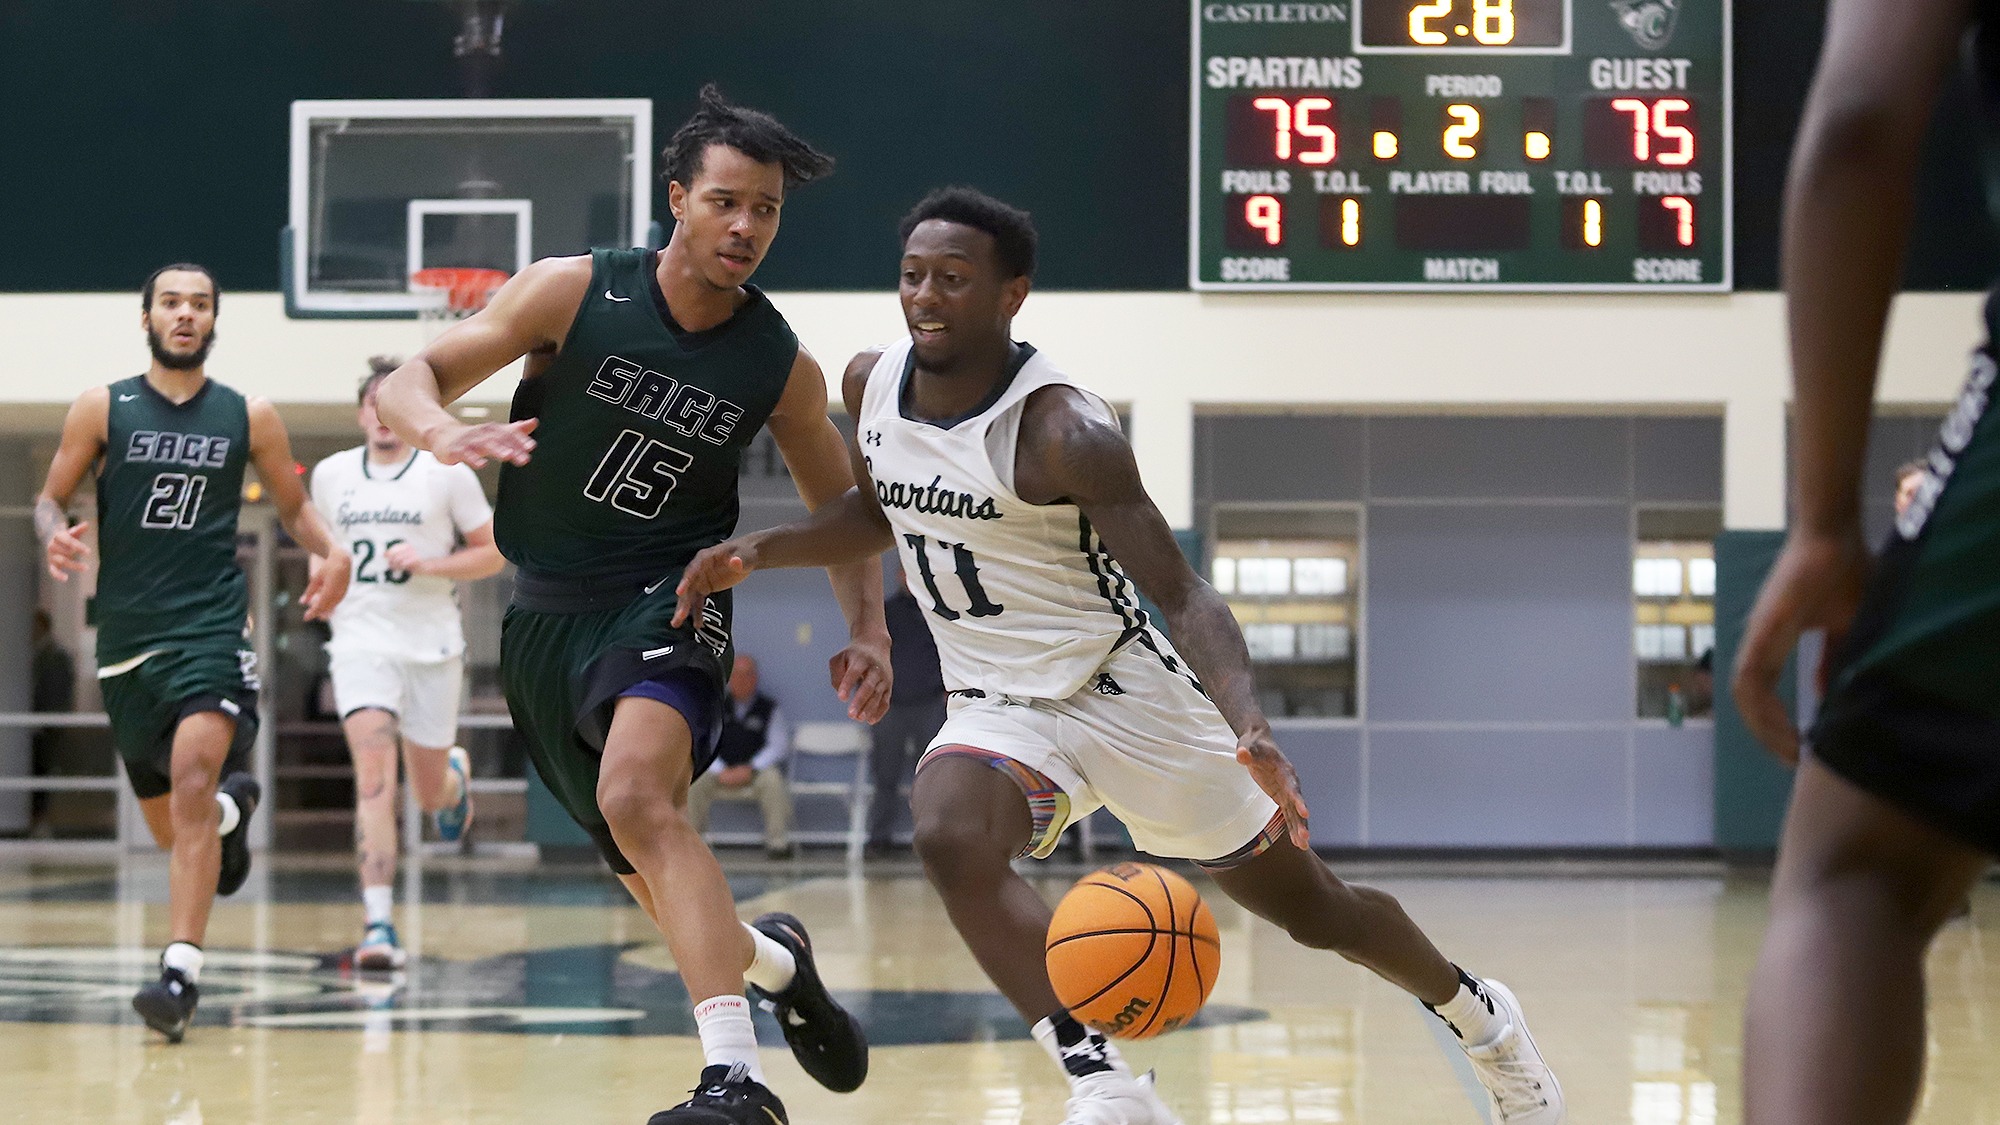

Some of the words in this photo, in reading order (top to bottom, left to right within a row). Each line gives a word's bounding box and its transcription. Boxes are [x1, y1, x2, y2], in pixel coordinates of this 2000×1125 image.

[1204, 3, 1346, 22] CASTLETON
[1409, 0, 1516, 45] 2.8
[1207, 56, 1362, 88] SPARTANS
[1426, 74, 1502, 97] PERIOD
[1590, 57, 1692, 90] GUEST
[1253, 98, 1336, 164] 75
[1443, 104, 1480, 159] 2
[1611, 99, 1694, 165] 75
[1221, 170, 1291, 193] FOULS
[1312, 170, 1371, 194] T.O.L.
[1389, 170, 1470, 194] PLAYER
[1479, 170, 1534, 194] FOUL
[1554, 171, 1613, 194] T.O.L.
[1633, 171, 1702, 195] FOULS
[1245, 195, 1281, 245] 9
[1342, 198, 1359, 245] 1
[1584, 199, 1601, 246] 1
[1661, 196, 1693, 246] 7
[1220, 257, 1291, 281] SCORE
[1424, 258, 1499, 281] MATCH
[1633, 258, 1702, 282] SCORE
[586, 355, 745, 446] SAGE
[125, 430, 231, 469] SAGE
[583, 428, 694, 519] 15
[141, 472, 208, 530] 21
[337, 501, 423, 534] Spartans
[903, 533, 1004, 621] 11
